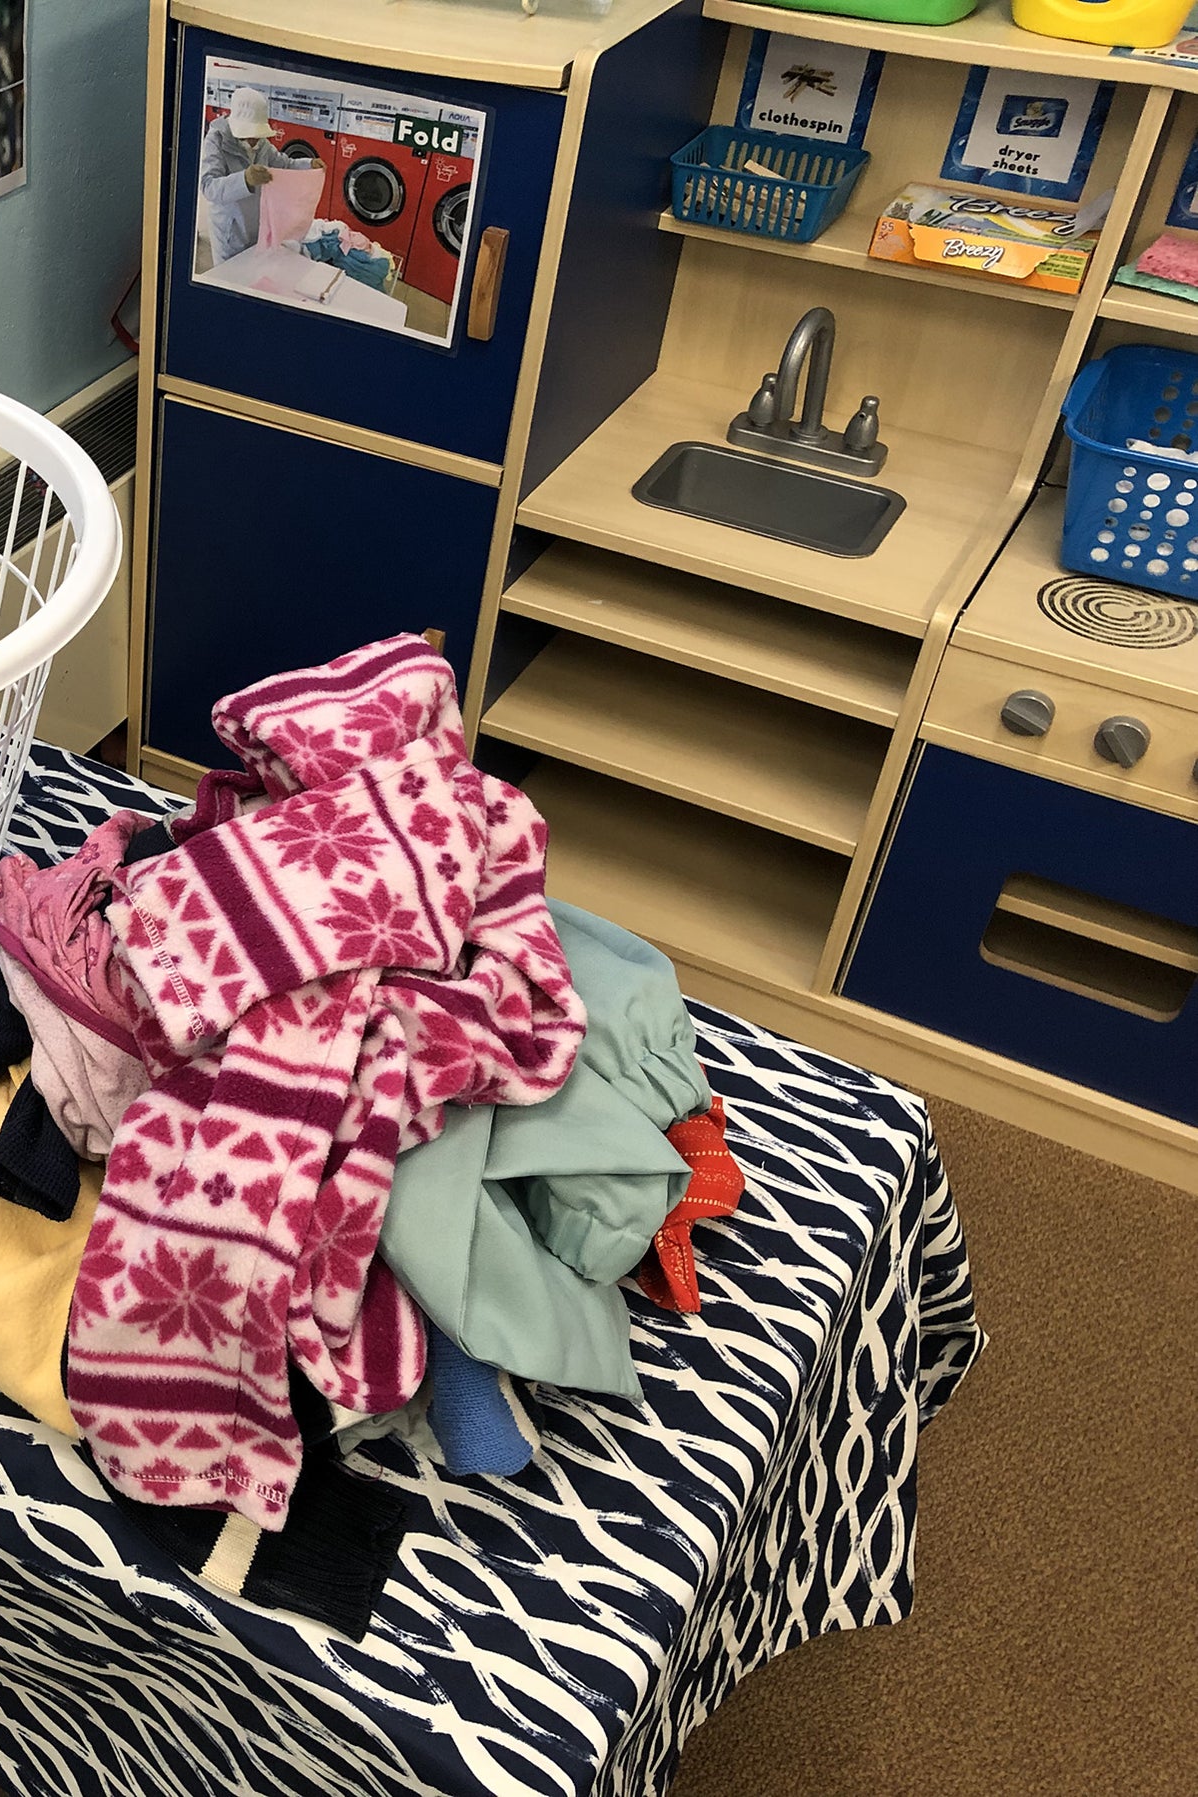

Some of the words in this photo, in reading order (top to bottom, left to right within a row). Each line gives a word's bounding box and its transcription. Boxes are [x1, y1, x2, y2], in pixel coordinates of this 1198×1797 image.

[758, 108, 844, 134] clothespin
[397, 119, 459, 152] Fold
[991, 157, 1039, 175] sheets
[998, 144, 1041, 162] dryer
[942, 239, 1004, 270] Breezy
